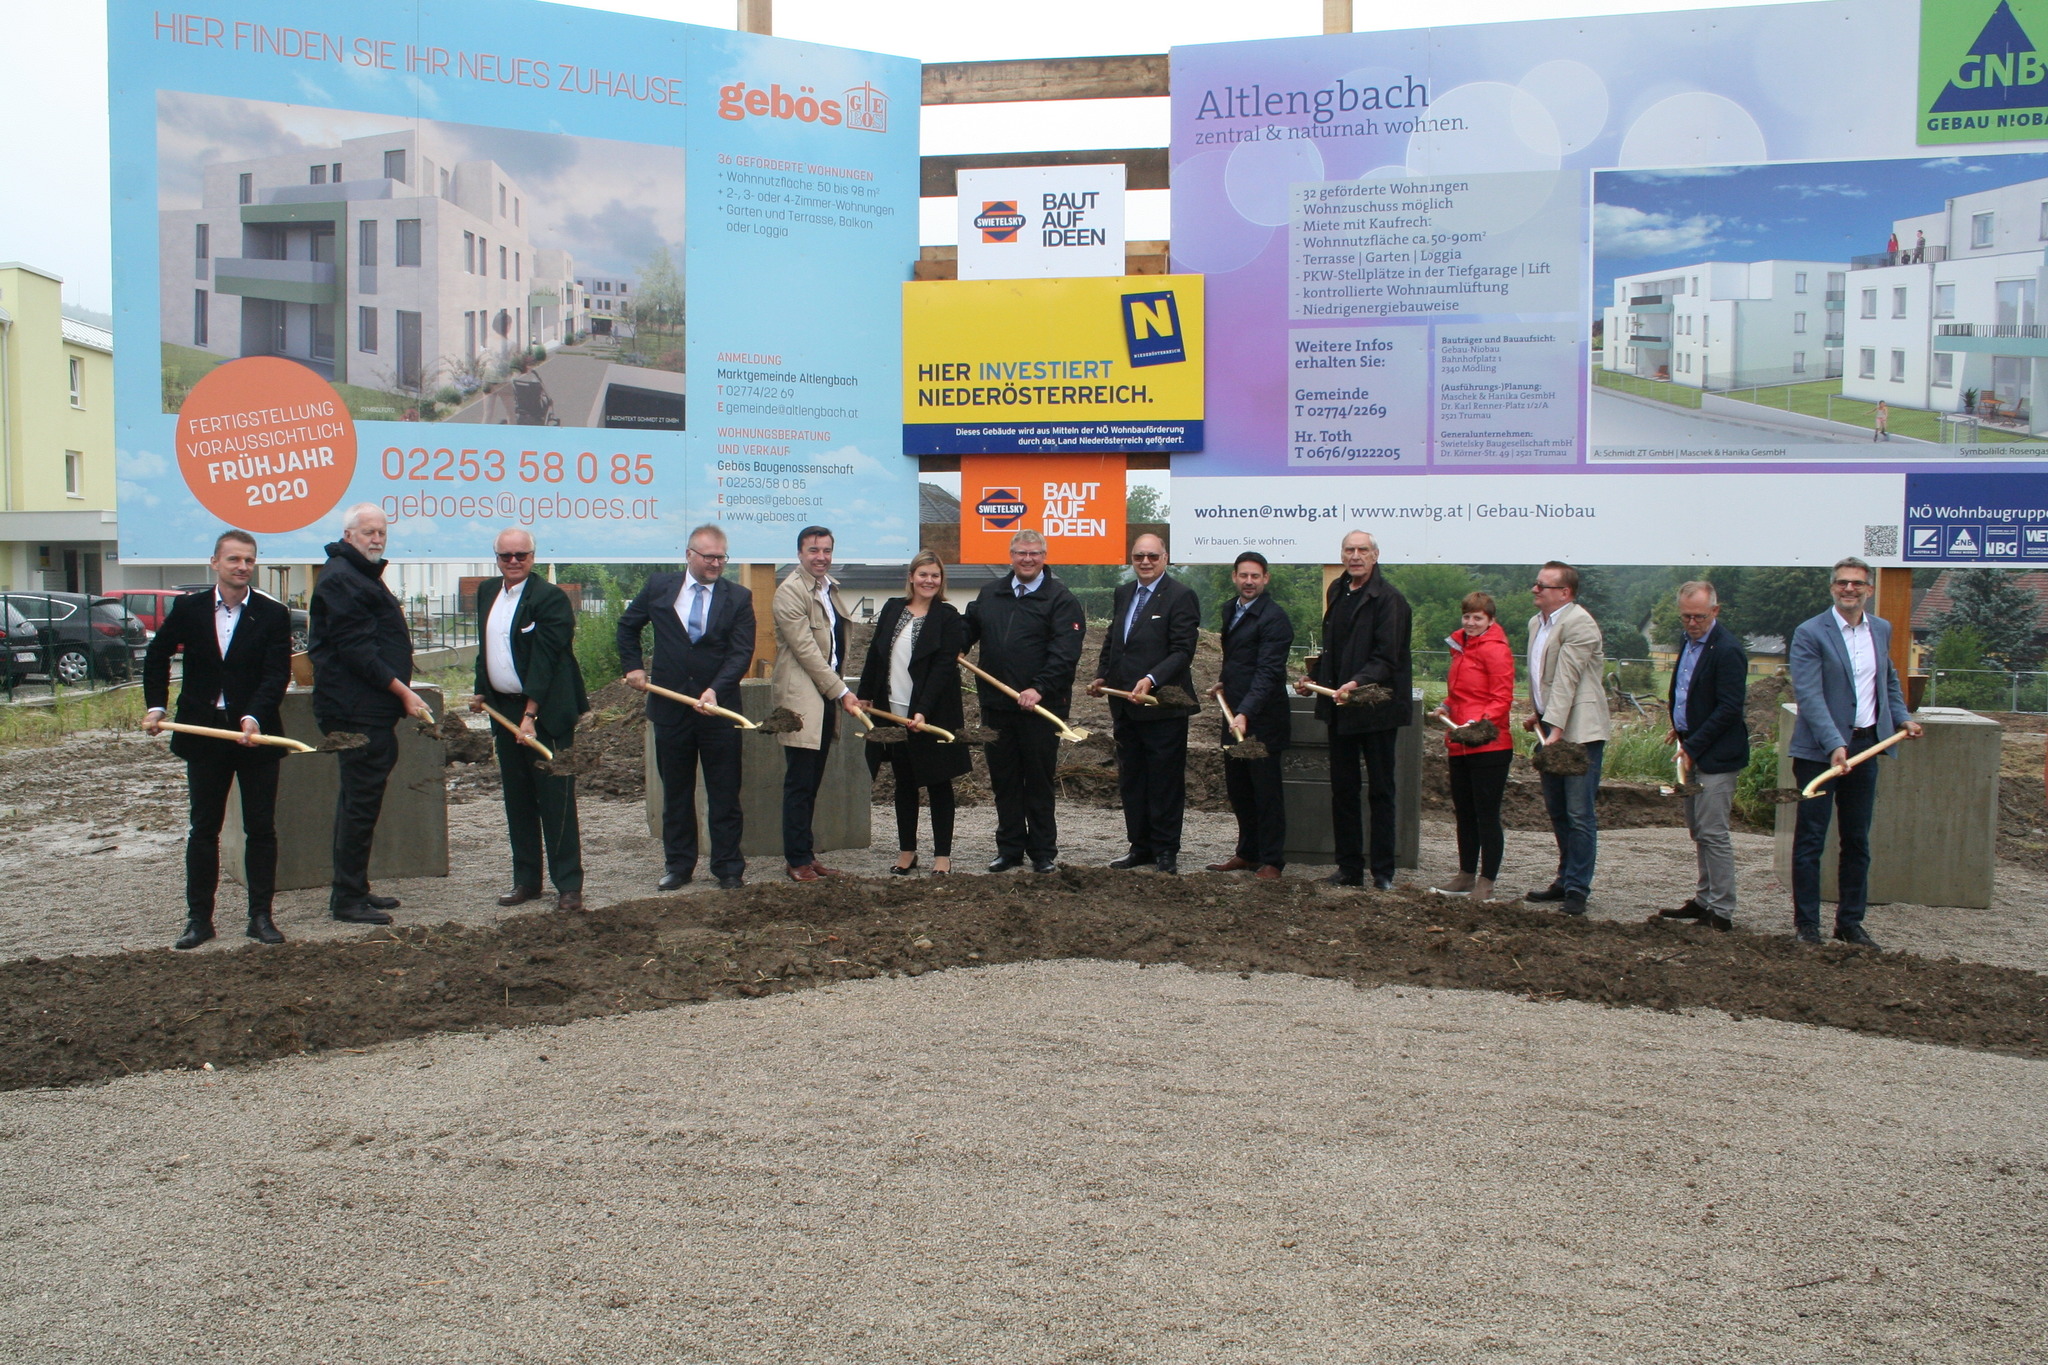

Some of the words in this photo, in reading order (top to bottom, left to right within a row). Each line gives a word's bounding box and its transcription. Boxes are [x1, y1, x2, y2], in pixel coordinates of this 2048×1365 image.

[155, 10, 224, 48] HIER
[235, 22, 343, 62] FINDEN
[353, 38, 396, 71] SIE
[406, 45, 450, 77] IHR
[459, 51, 550, 88] NEUES
[558, 65, 687, 106] ZUHAUSE.
[1950, 52, 2045, 89] GNB
[718, 82, 842, 126] gebös
[1196, 75, 1430, 124] Altlengbach
[1927, 116, 1989, 131] GEBAU
[1997, 113, 2048, 127] NIOB
[1196, 124, 1260, 145] zentral
[1266, 124, 1281, 140] &
[1288, 119, 1378, 140] naturnah
[1384, 116, 1468, 134] wohnen.
[718, 154, 732, 164] 36
[736, 155, 803, 173] GEFÖRDERTE
[807, 164, 873, 181] WOHNUNGEN
[727, 171, 814, 191] Wohnnutzfläche:
[818, 182, 830, 192] 50
[834, 183, 848, 195] bis
[851, 186, 864, 196] 98
[1043, 192, 1099, 210] BAUT
[1304, 190, 1316, 200] 32
[1320, 185, 1386, 201] geförderte
[744, 189, 754, 199] 3-
[758, 191, 780, 203] oder
[784, 193, 894, 217] 4-Zimmer-Wohnungen
[1304, 201, 1398, 215] Wohnzuschuss
[1402, 198, 1453, 213] möglich
[727, 204, 762, 218] Garten
[766, 209, 785, 220] und
[789, 211, 836, 227] Terrasse,
[839, 216, 872, 229] Balkon
[977, 216, 1023, 227] SWIETELSKY
[1042, 211, 1084, 229] AUF
[727, 222, 750, 233] oder
[754, 224, 788, 238] Loggia
[1304, 219, 1340, 232] Miete
[1344, 218, 1365, 230] mit
[1043, 228, 1105, 247] IDEEN
[1304, 234, 1409, 248] Wohnnutzfläche
[1412, 234, 1429, 245] ca.
[1303, 253, 1355, 265] Terrasse
[1366, 251, 1409, 263] Garten
[1421, 250, 1462, 264] Loggia
[1303, 267, 1404, 283] PKW-Stellplätze
[1408, 267, 1421, 279] in
[1425, 266, 1444, 278] der
[1448, 264, 1517, 280] Tiefgarage
[1528, 263, 1550, 274] Lift
[1303, 285, 1383, 298] kontrollierte
[1303, 301, 1459, 316] Niedrigenergiebauweise
[1130, 299, 1173, 340] N
[1295, 341, 1352, 352] Weitere
[1356, 339, 1393, 351] Infos
[1442, 337, 1482, 345] Bauträger
[718, 352, 782, 365] ANMELDUNG
[1295, 356, 1356, 368] erhalten
[1360, 355, 1385, 367] Sie:
[1442, 356, 1496, 364] Bahnhofplatz
[919, 363, 970, 382] HIER
[979, 360, 1113, 380] INVESTIERT
[1442, 366, 1460, 374] 2340
[1462, 364, 1496, 372] Mödling
[718, 369, 796, 383] Marktgemeinde
[800, 374, 857, 387] Altlengbach
[726, 386, 777, 398] 02774/22
[781, 389, 794, 398] 69
[919, 383, 1153, 406] NIEDERÖSTERREICH.
[1295, 388, 1368, 400] Gemeinde
[189, 401, 334, 435] FERTIGSTELLUNG
[726, 402, 858, 419] gemeinde@altlengbach.at
[1308, 404, 1386, 419] 02774/2269
[718, 428, 830, 441] WOHNUNGSBERATUNG
[956, 428, 980, 436] Dieses
[983, 427, 1016, 436] Gebäude
[1018, 426, 1034, 434] wird
[1052, 426, 1079, 434] Mitteln
[1081, 426, 1094, 434] der
[1096, 425, 1108, 434] NÖ
[1111, 426, 1184, 436] Wohnbauförderung
[1295, 431, 1316, 442] Hr.
[1320, 430, 1352, 442] Toth
[187, 422, 344, 458] VORAUSSICHTLICH
[1018, 437, 1040, 445] durch
[1058, 436, 1077, 444] Land
[1080, 436, 1143, 444] Niederösterreich
[1145, 436, 1184, 445] gefördert.
[1486, 440, 1549, 448] Baugesellschaft
[718, 444, 739, 454] UND
[743, 445, 790, 456] VERKAUF
[1307, 446, 1400, 460] 0676/9122205
[1604, 449, 1635, 457] Schmidt
[208, 446, 335, 483] FRÜHJAHR
[382, 447, 505, 482] 02253
[519, 450, 564, 483] 58
[577, 452, 598, 483] 0
[610, 454, 654, 485] 85
[718, 461, 750, 472] Gebös
[754, 462, 854, 475] Baugenossenschaft
[726, 478, 779, 489] 02253/58
[793, 479, 806, 489] 85
[1043, 482, 1100, 500] BAUT
[246, 478, 308, 506] 2020
[382, 489, 658, 526] geboes@geboes.at
[726, 494, 823, 507] geboes@geboes.at
[979, 504, 1024, 514] SWIETELSKY
[1042, 501, 1085, 518] AUF
[1195, 504, 1337, 521] wohnen@nwbg.at
[1351, 504, 1463, 521] www.nwbg.at
[1477, 503, 1595, 519] Gebau-Niobau
[1910, 504, 1931, 519] NÖ
[1935, 506, 2048, 522] Wohnbaugrupp
[726, 511, 807, 524] www.geboes.at
[1044, 519, 1105, 536] IDEEN
[1195, 536, 1209, 546] Wir
[1211, 536, 1241, 546] bauen.
[1243, 536, 1256, 546] Sie
[1258, 536, 1297, 546] wohnen.
[1986, 542, 2017, 555] NBG
